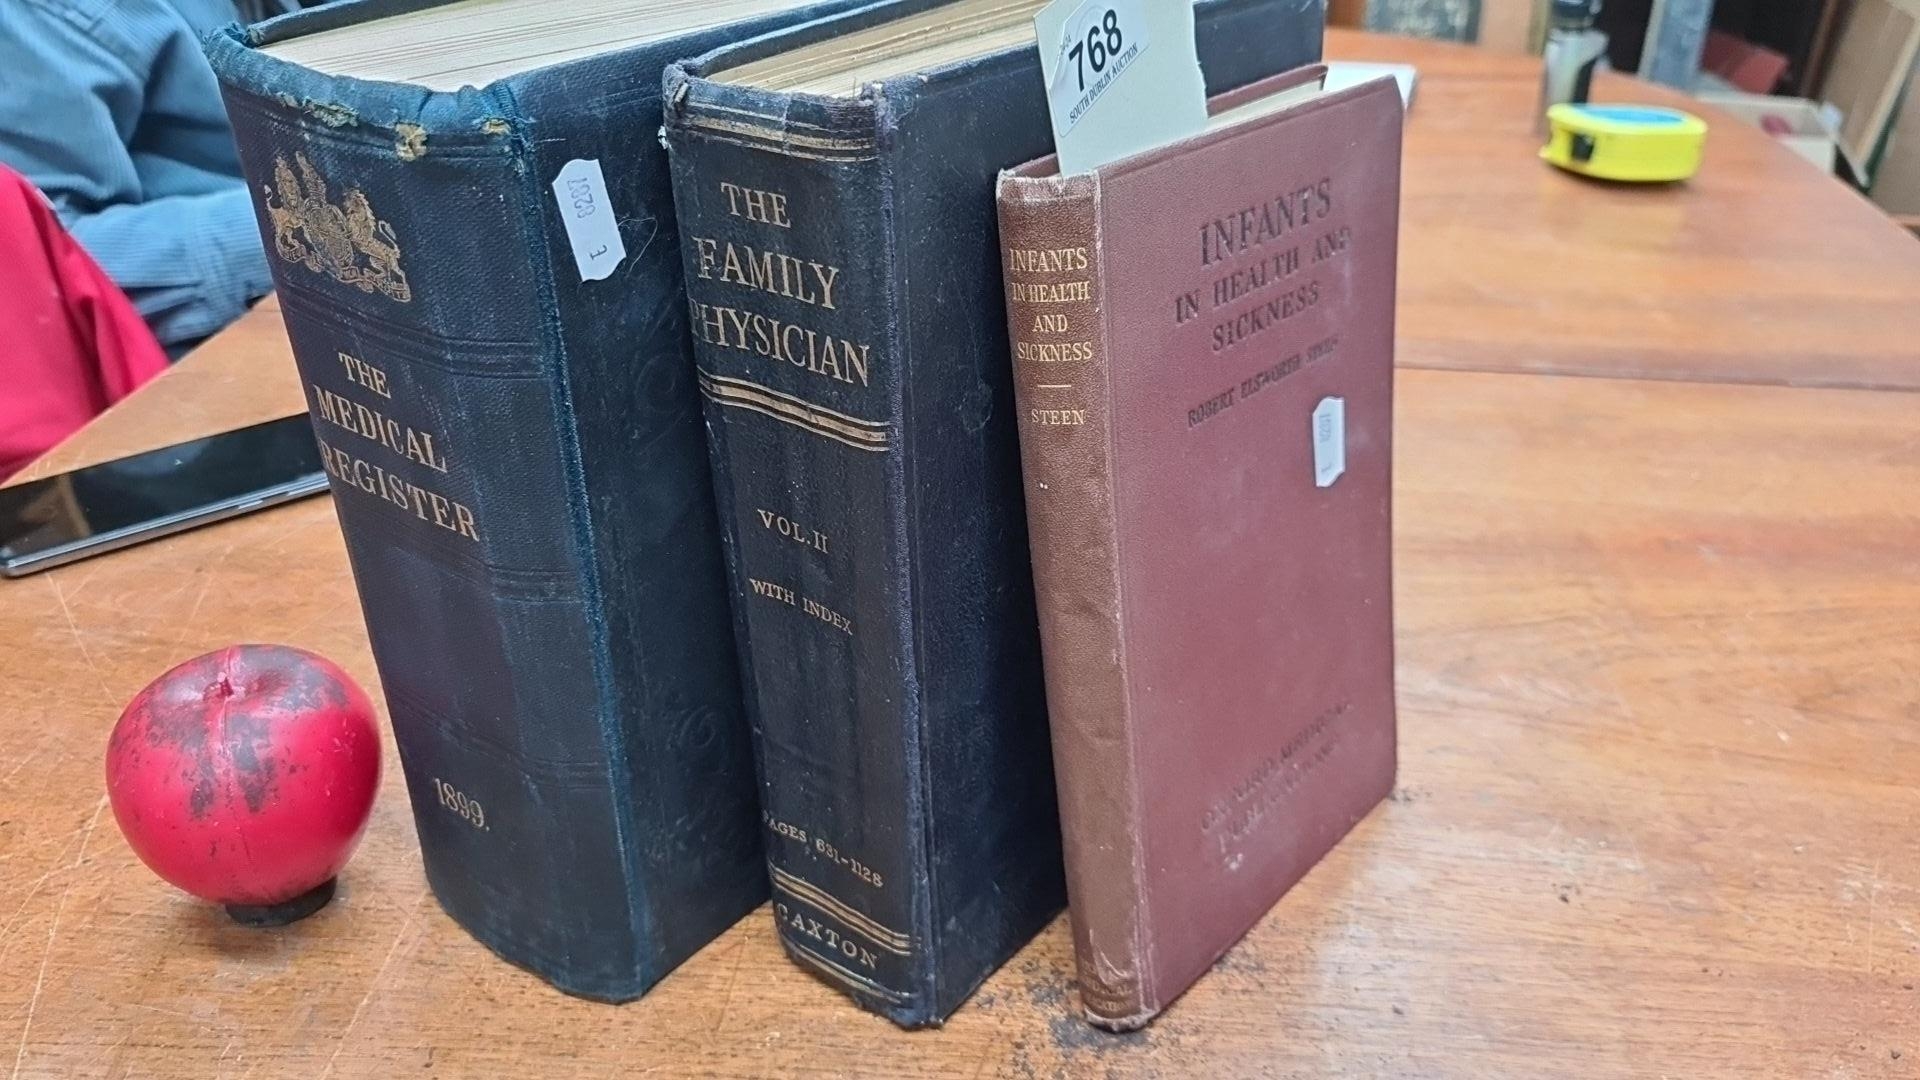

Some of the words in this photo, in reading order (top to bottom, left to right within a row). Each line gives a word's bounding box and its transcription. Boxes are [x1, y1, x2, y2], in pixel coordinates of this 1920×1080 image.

[1068, 9, 1122, 92] 768
[1069, 93, 1090, 124] SOUTH
[1089, 70, 1111, 101] DUBLIN
[1112, 42, 1138, 77] AUCTION
[720, 182, 791, 228] THE
[1200, 177, 1332, 266] INFANTS
[691, 235, 839, 309] FAMILY
[1009, 247, 1088, 271] INFANTS
[1174, 289, 1201, 323] IN
[1213, 247, 1299, 308] HEALTH
[1012, 283, 1025, 302] IN
[1029, 281, 1090, 302] HEALTH
[1212, 280, 1320, 351] SICKNESS
[688, 298, 870, 387] PHYSICIAN
[1017, 341, 1093, 362] SICKNESS
[1032, 314, 1068, 332] AND
[338, 351, 391, 399] THE
[313, 385, 448, 473] MEDICAL
[1032, 409, 1086, 425] STEEN
[1187, 387, 1234, 427] ROBERT
[319, 437, 480, 541] REGISTER
[749, 577, 796, 606] WITH
[802, 597, 853, 636] INDEX
[433, 777, 490, 832] 1899.
[816, 838, 883, 888] 631-1128
[777, 903, 880, 969] CAXTON
